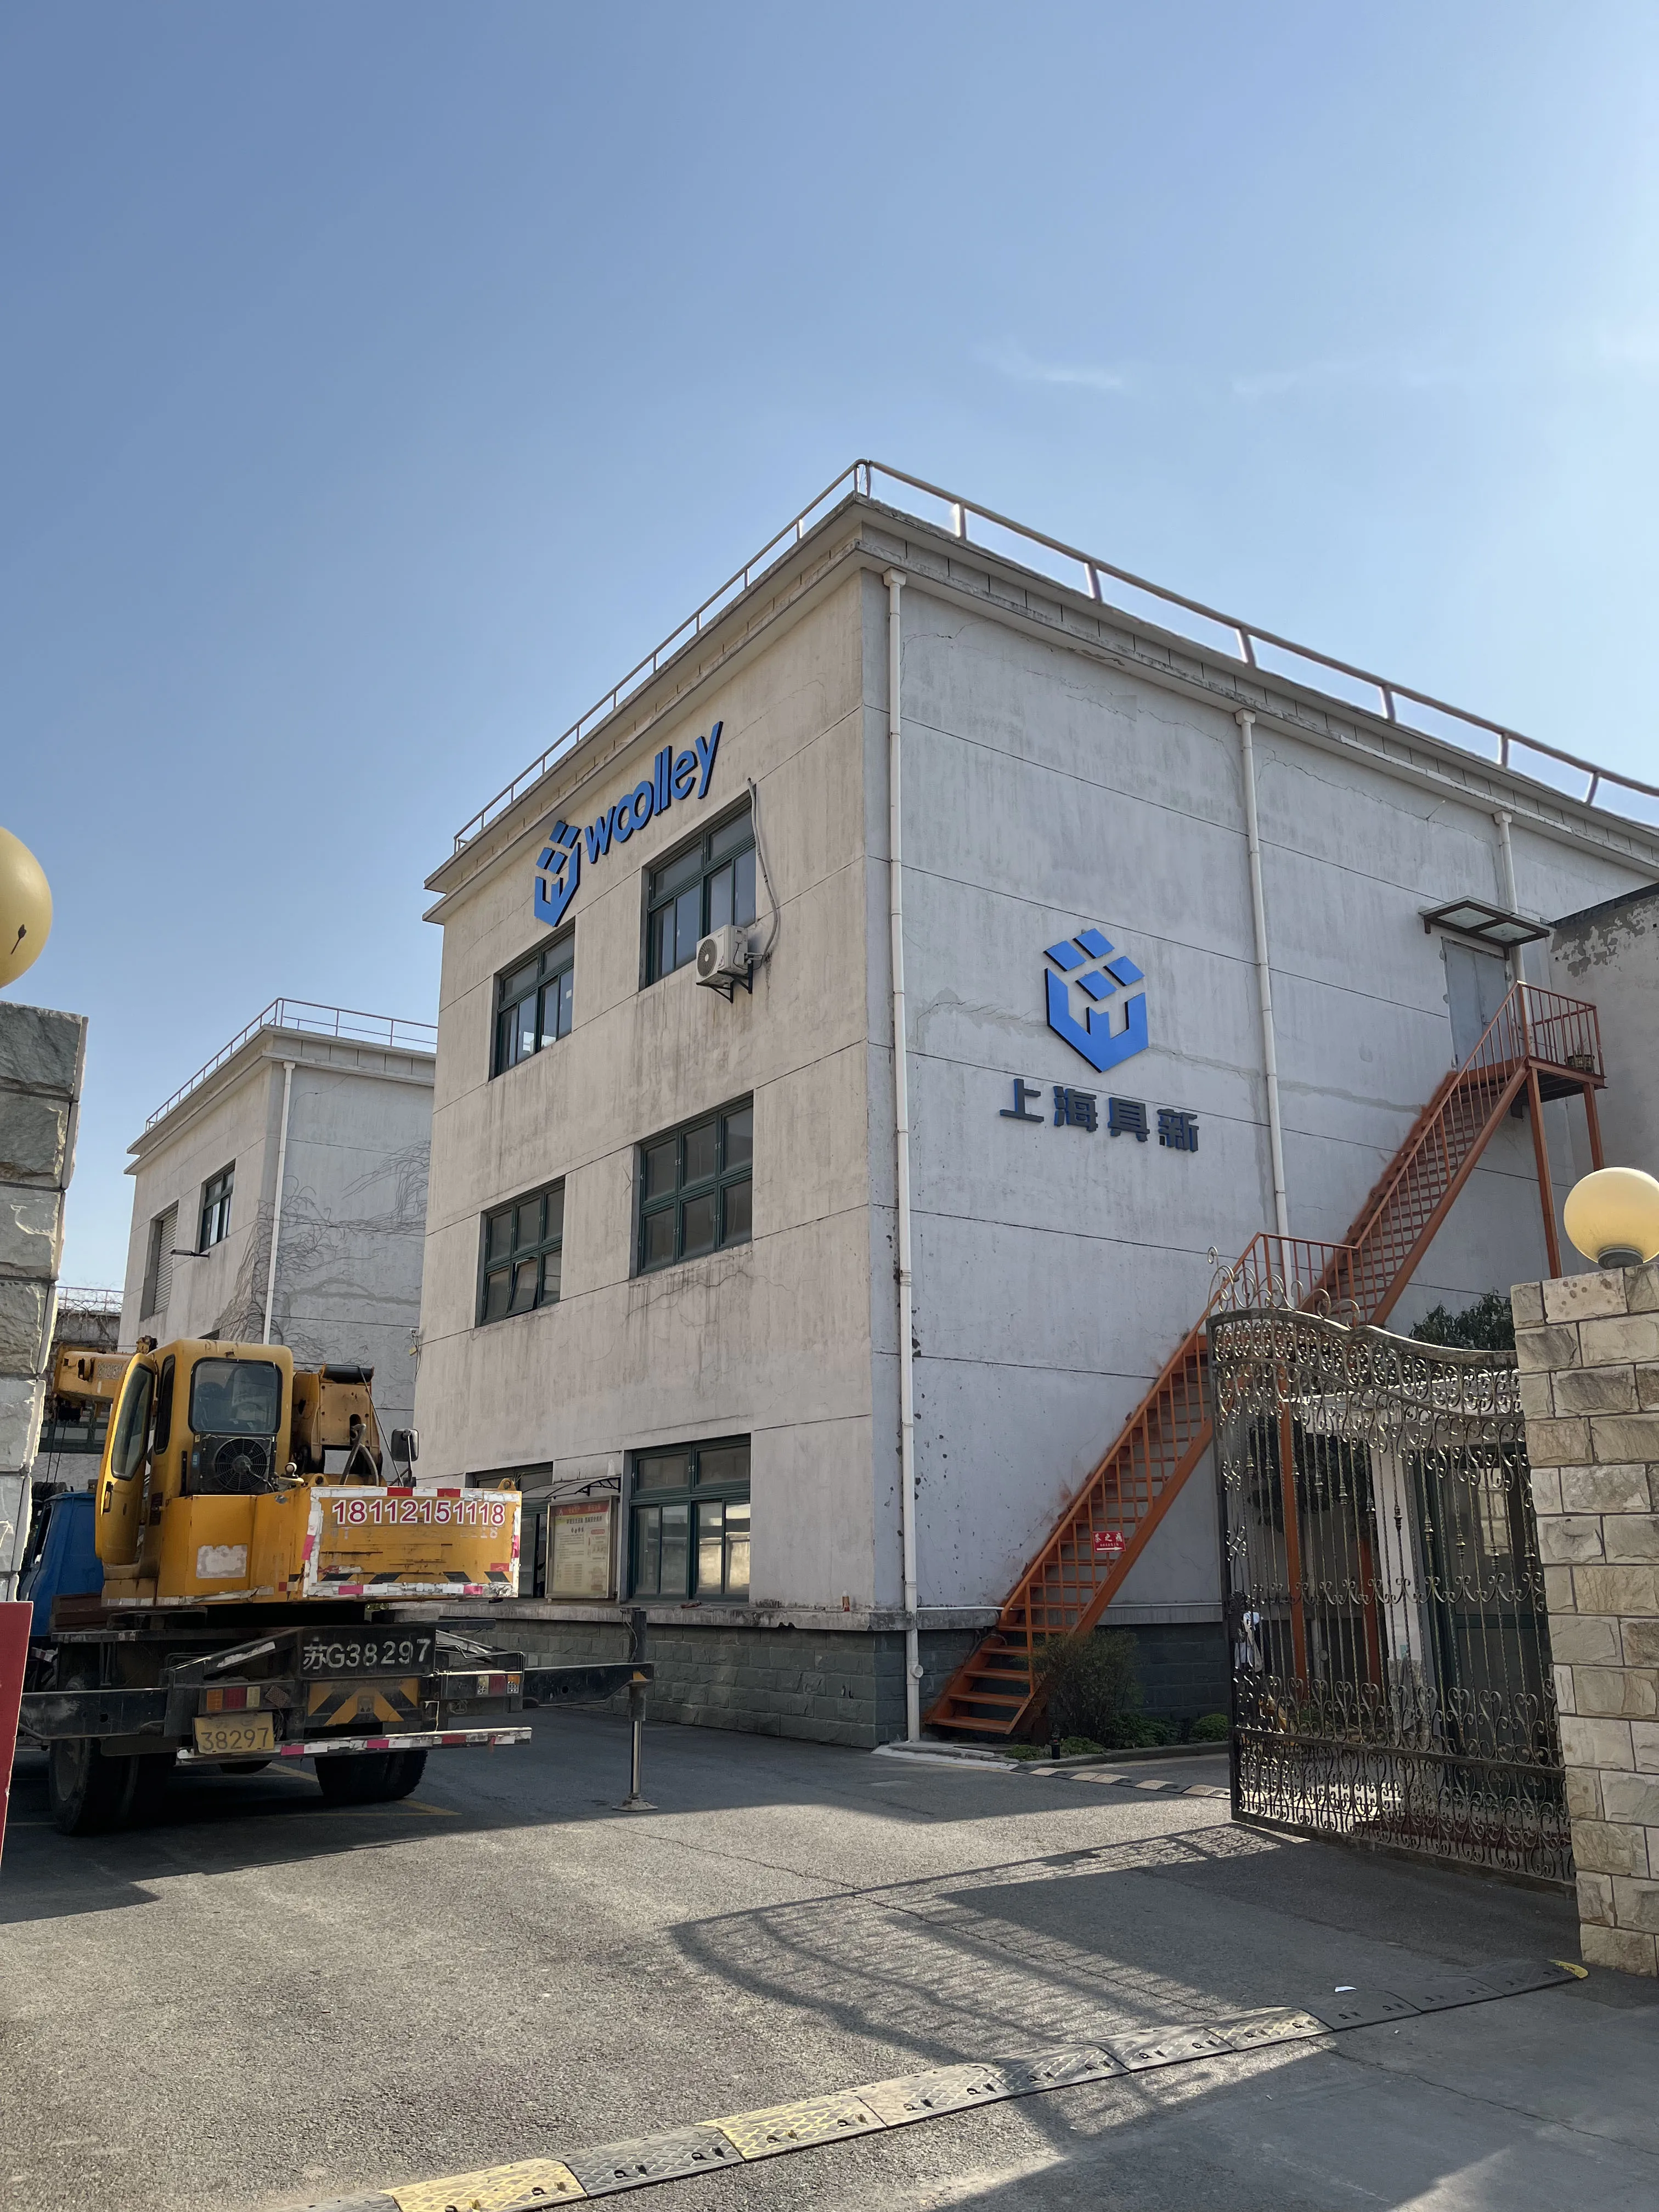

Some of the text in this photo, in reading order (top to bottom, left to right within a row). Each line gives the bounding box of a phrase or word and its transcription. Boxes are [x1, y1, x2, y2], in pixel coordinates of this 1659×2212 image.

[584, 721, 723, 864] woolley
[1000, 1078, 1199, 1152] 上海具新
[332, 1499, 505, 1526] 18112151118
[302, 1637, 431, 1670] 苏G38297
[201, 1727, 269, 1751] 38297
